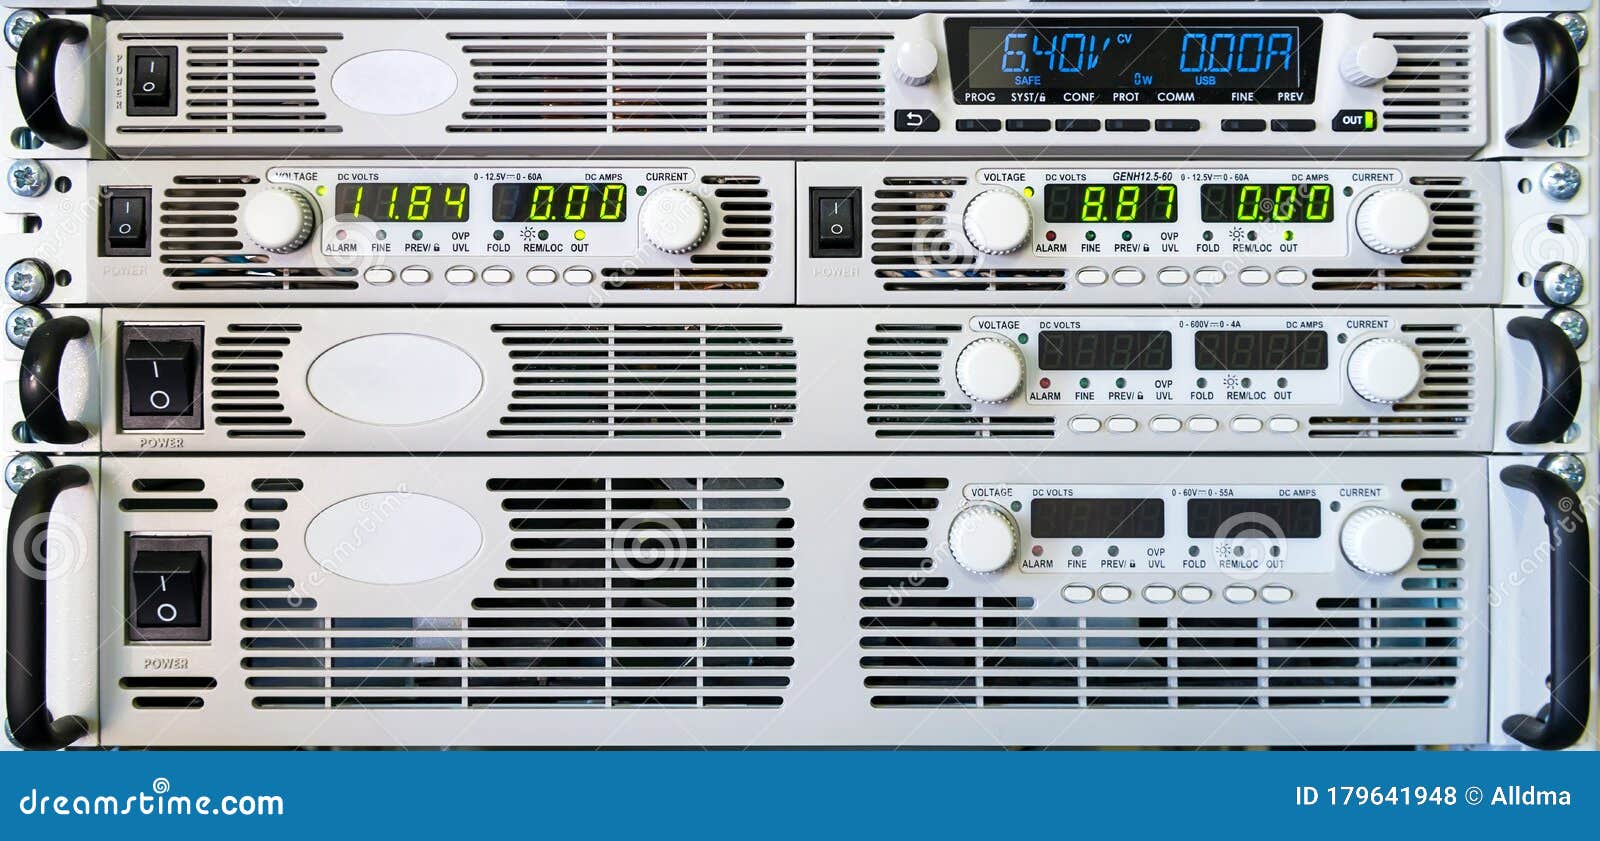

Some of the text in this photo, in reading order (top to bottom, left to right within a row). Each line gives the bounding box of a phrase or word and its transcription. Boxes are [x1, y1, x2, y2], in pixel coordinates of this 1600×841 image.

[1117, 34, 1131, 44] CV
[1180, 33, 1292, 72] 0.00A
[1015, 76, 1040, 85] SAFE
[1195, 76, 1216, 85] USB
[965, 93, 995, 102] PROG
[1064, 93, 1094, 101] CONF
[1113, 93, 1139, 101] PROT
[1158, 93, 1194, 101] COMM
[1232, 92, 1253, 101] FINE
[1278, 92, 1303, 101] PREV
[1343, 116, 1362, 124] OUT
[646, 173, 688, 181] CURRENT
[984, 173, 1025, 181] VOLTAGE
[1113, 172, 1172, 181] GENH12.5-60
[1352, 173, 1394, 181] CURRENT
[353, 185, 465, 220] 11.84
[530, 185, 624, 220] 0.00
[1082, 186, 1175, 221] 8.87
[1237, 184, 1330, 221] 0.00
[452, 232, 470, 240] OVP
[1161, 232, 1178, 240] OVP
[372, 244, 391, 252] FINE
[453, 244, 469, 252] UVL
[487, 244, 510, 252] FOLD
[524, 244, 563, 252] REM/LOC
[571, 244, 589, 252] OUT
[1036, 244, 1066, 252] ALARM
[1082, 244, 1100, 252] FINE
[1162, 244, 1179, 252] UVL
[1197, 244, 1219, 252] FOLD
[1233, 244, 1272, 252] REM/LOC
[1280, 244, 1298, 252] OUT
[979, 321, 1019, 329] VOLTAGE
[1347, 320, 1388, 328] CURRENT
[1155, 380, 1172, 388] OVP
[1030, 392, 1060, 400] ALARM
[1076, 392, 1094, 400] FINE
[1156, 392, 1173, 400] UVL
[1191, 392, 1213, 400] FOLD
[1227, 392, 1266, 400] REM/LOC
[1274, 392, 1292, 400] OUT
[140, 437, 184, 449] POWER
[972, 488, 1012, 496] VOLTAGE
[1147, 548, 1165, 556] OVP
[1022, 560, 1053, 568] ALARM
[1068, 560, 1086, 568] FINE
[1149, 560, 1165, 568] UVL
[1183, 560, 1206, 568] FOLD
[1220, 560, 1258, 568] REM/LOC
[1266, 560, 1284, 568] OUT
[144, 658, 189, 670] POWER
